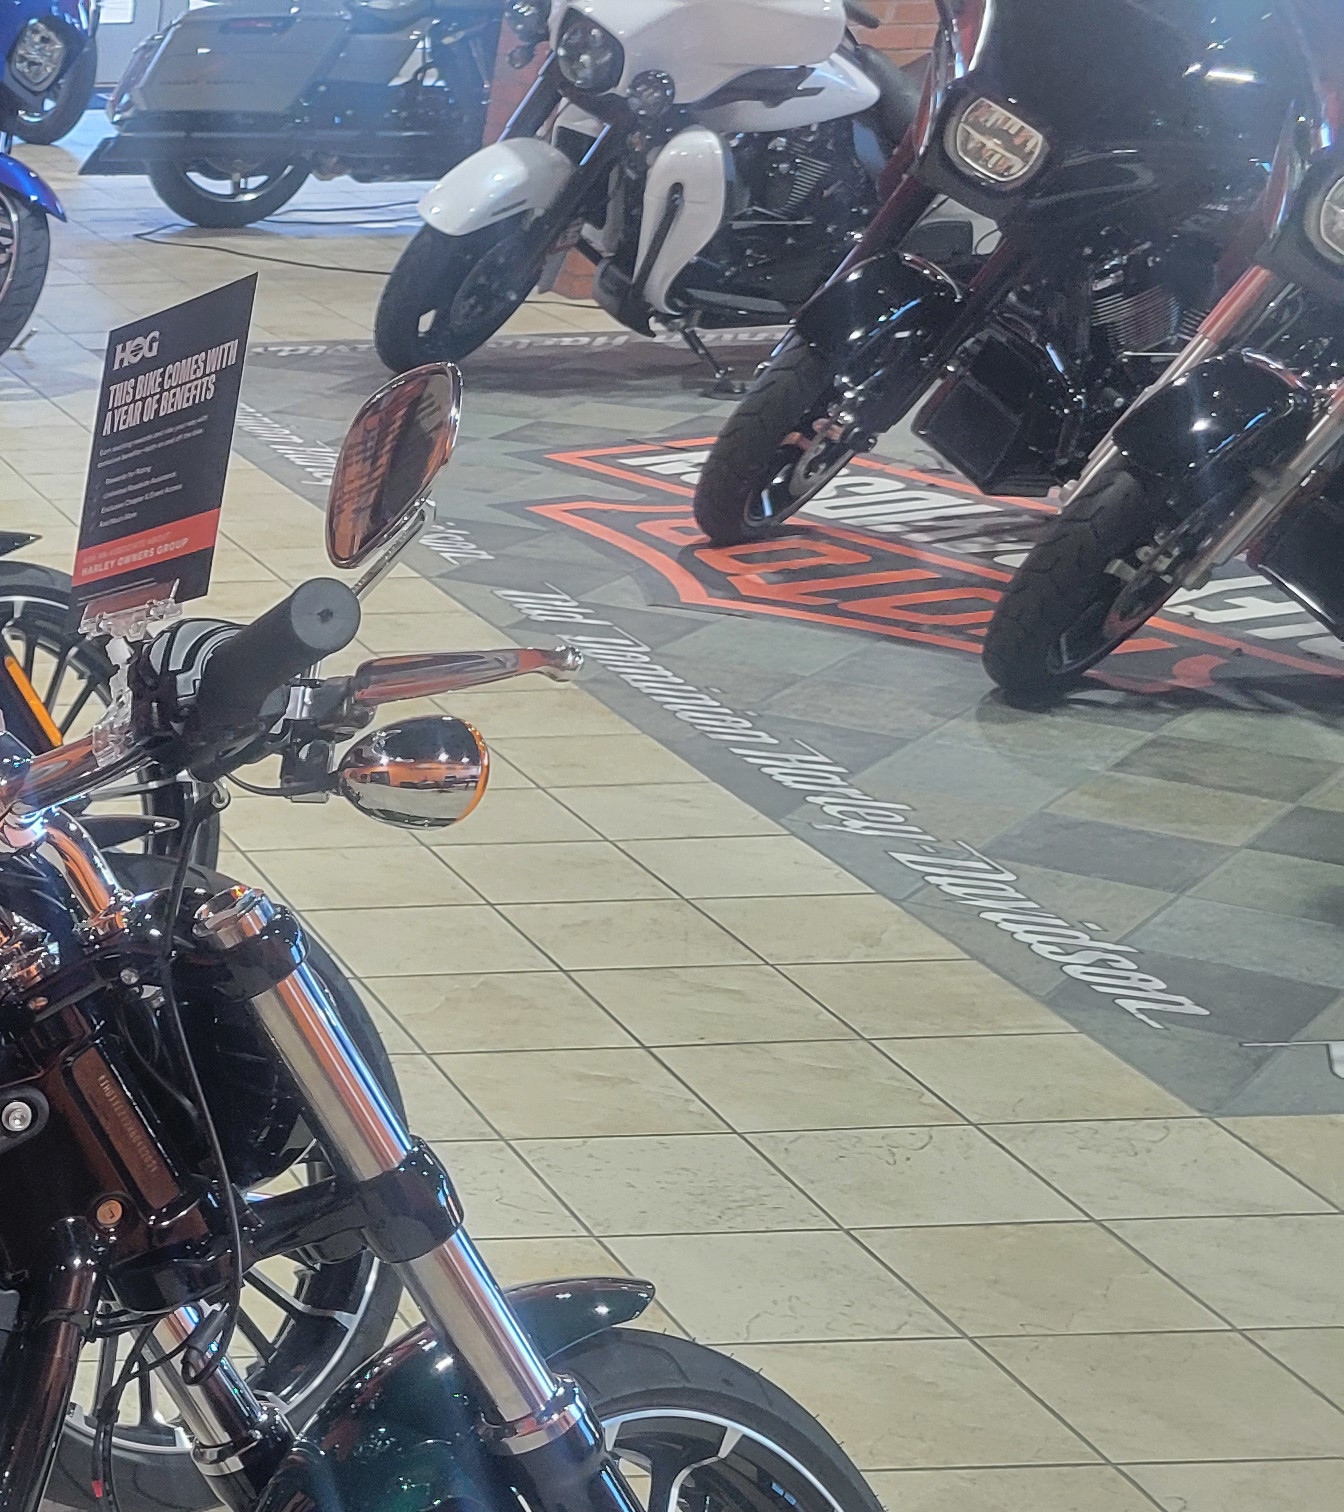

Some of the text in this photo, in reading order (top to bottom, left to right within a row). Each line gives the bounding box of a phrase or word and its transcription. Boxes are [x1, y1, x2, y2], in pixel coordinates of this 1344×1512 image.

[108, 338, 239, 410] THIS BIKE COMES WITH
[112, 330, 161, 371] HOG
[101, 373, 216, 437] A YEAR OF BENEFITS
[81, 537, 190, 577] HARLEY OWNERS GROUP
[491, 580, 612, 628] Old
[558, 626, 782, 750] Dominion
